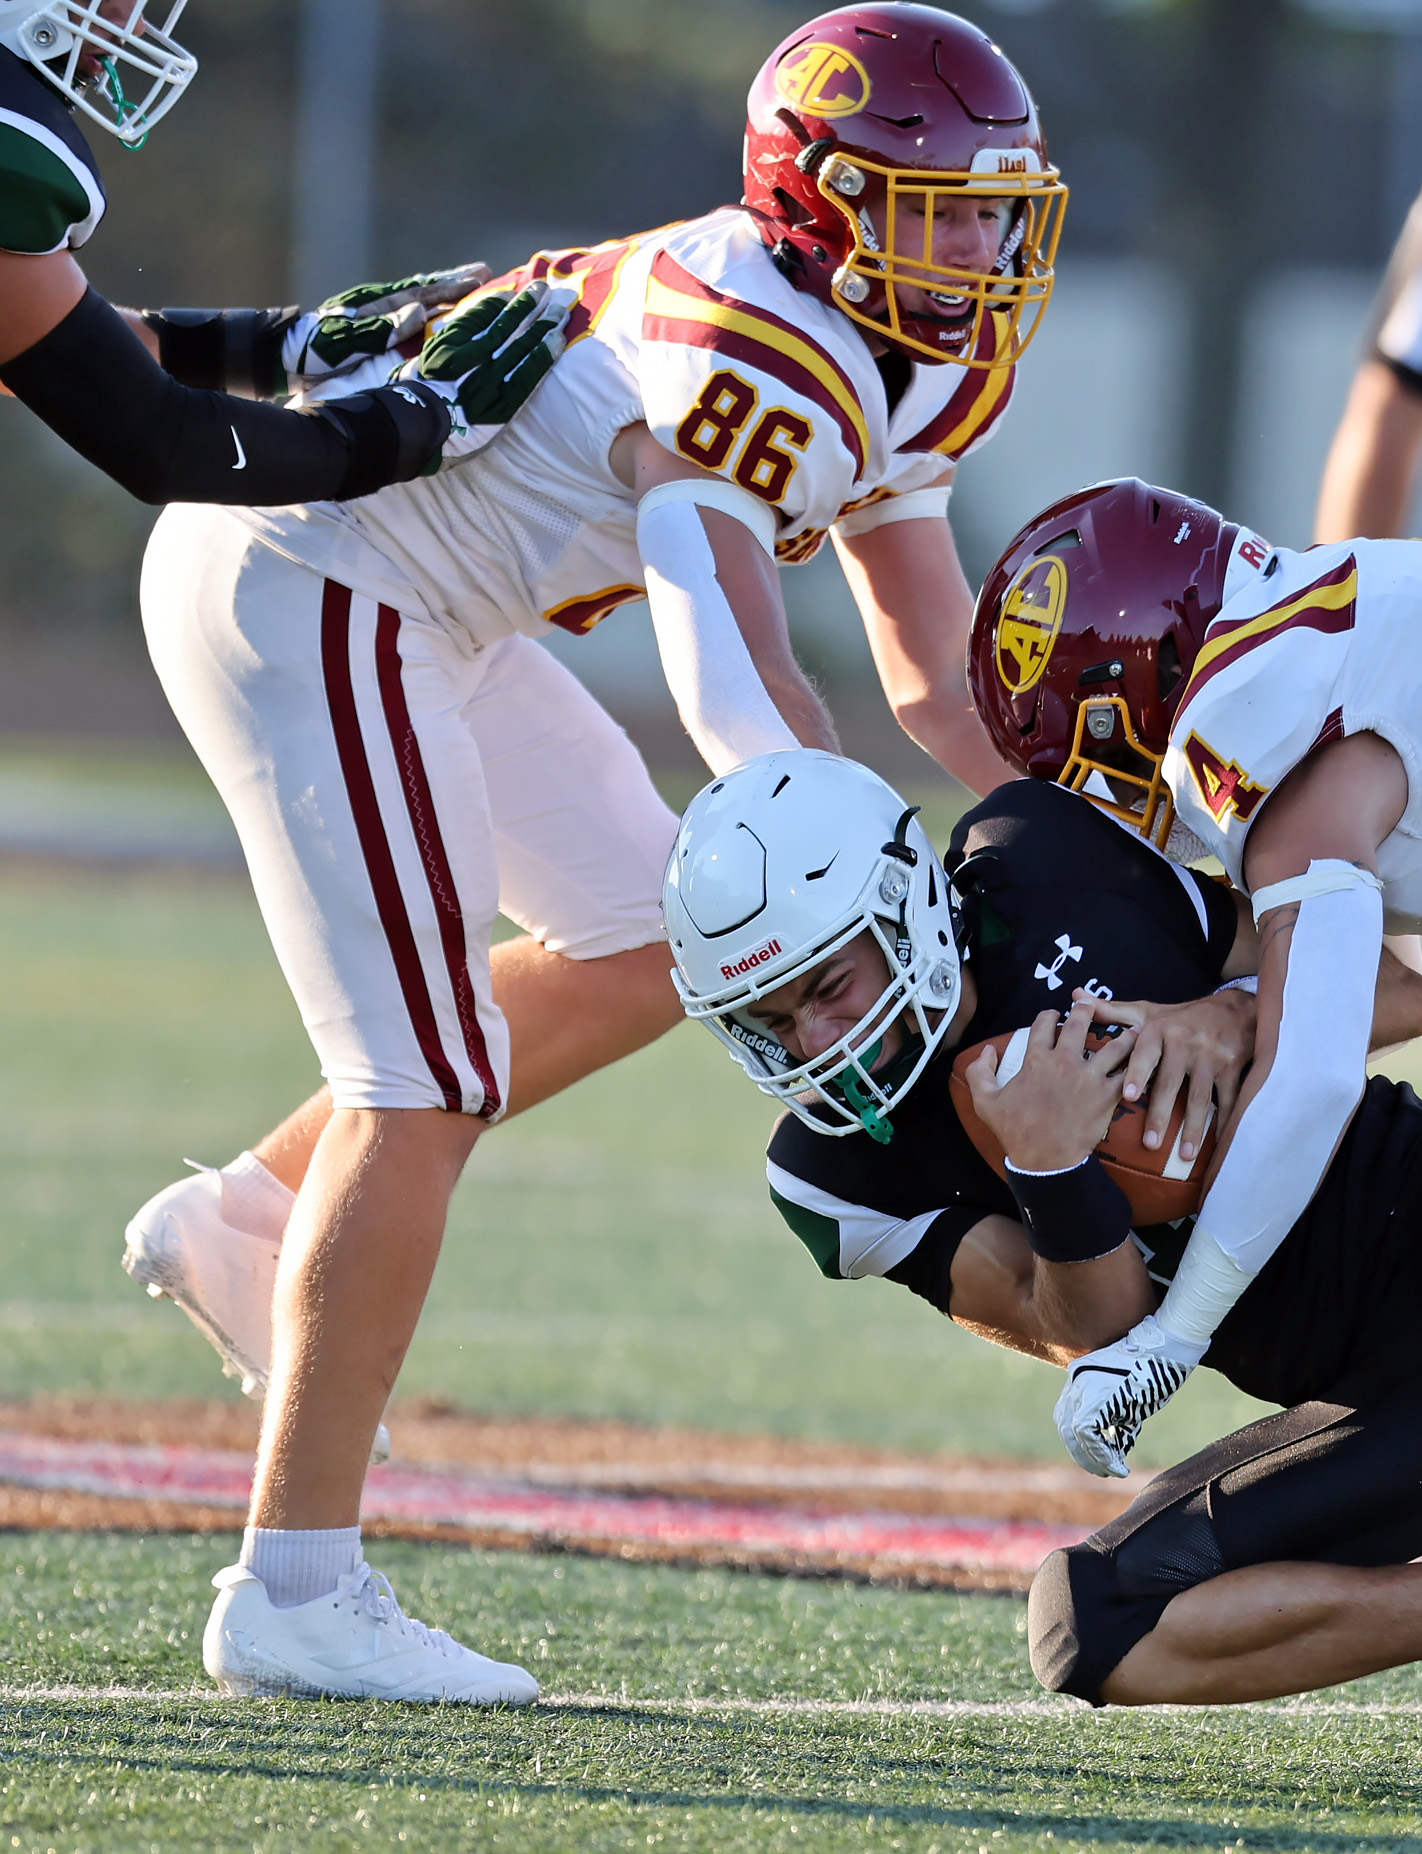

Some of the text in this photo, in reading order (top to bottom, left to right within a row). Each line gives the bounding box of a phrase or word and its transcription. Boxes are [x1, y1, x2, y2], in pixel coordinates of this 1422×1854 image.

[778, 46, 860, 112] AC
[674, 368, 815, 505] 86
[1000, 563, 1061, 687] AC
[1182, 728, 1272, 824] 4
[720, 939, 783, 981] Riddell
